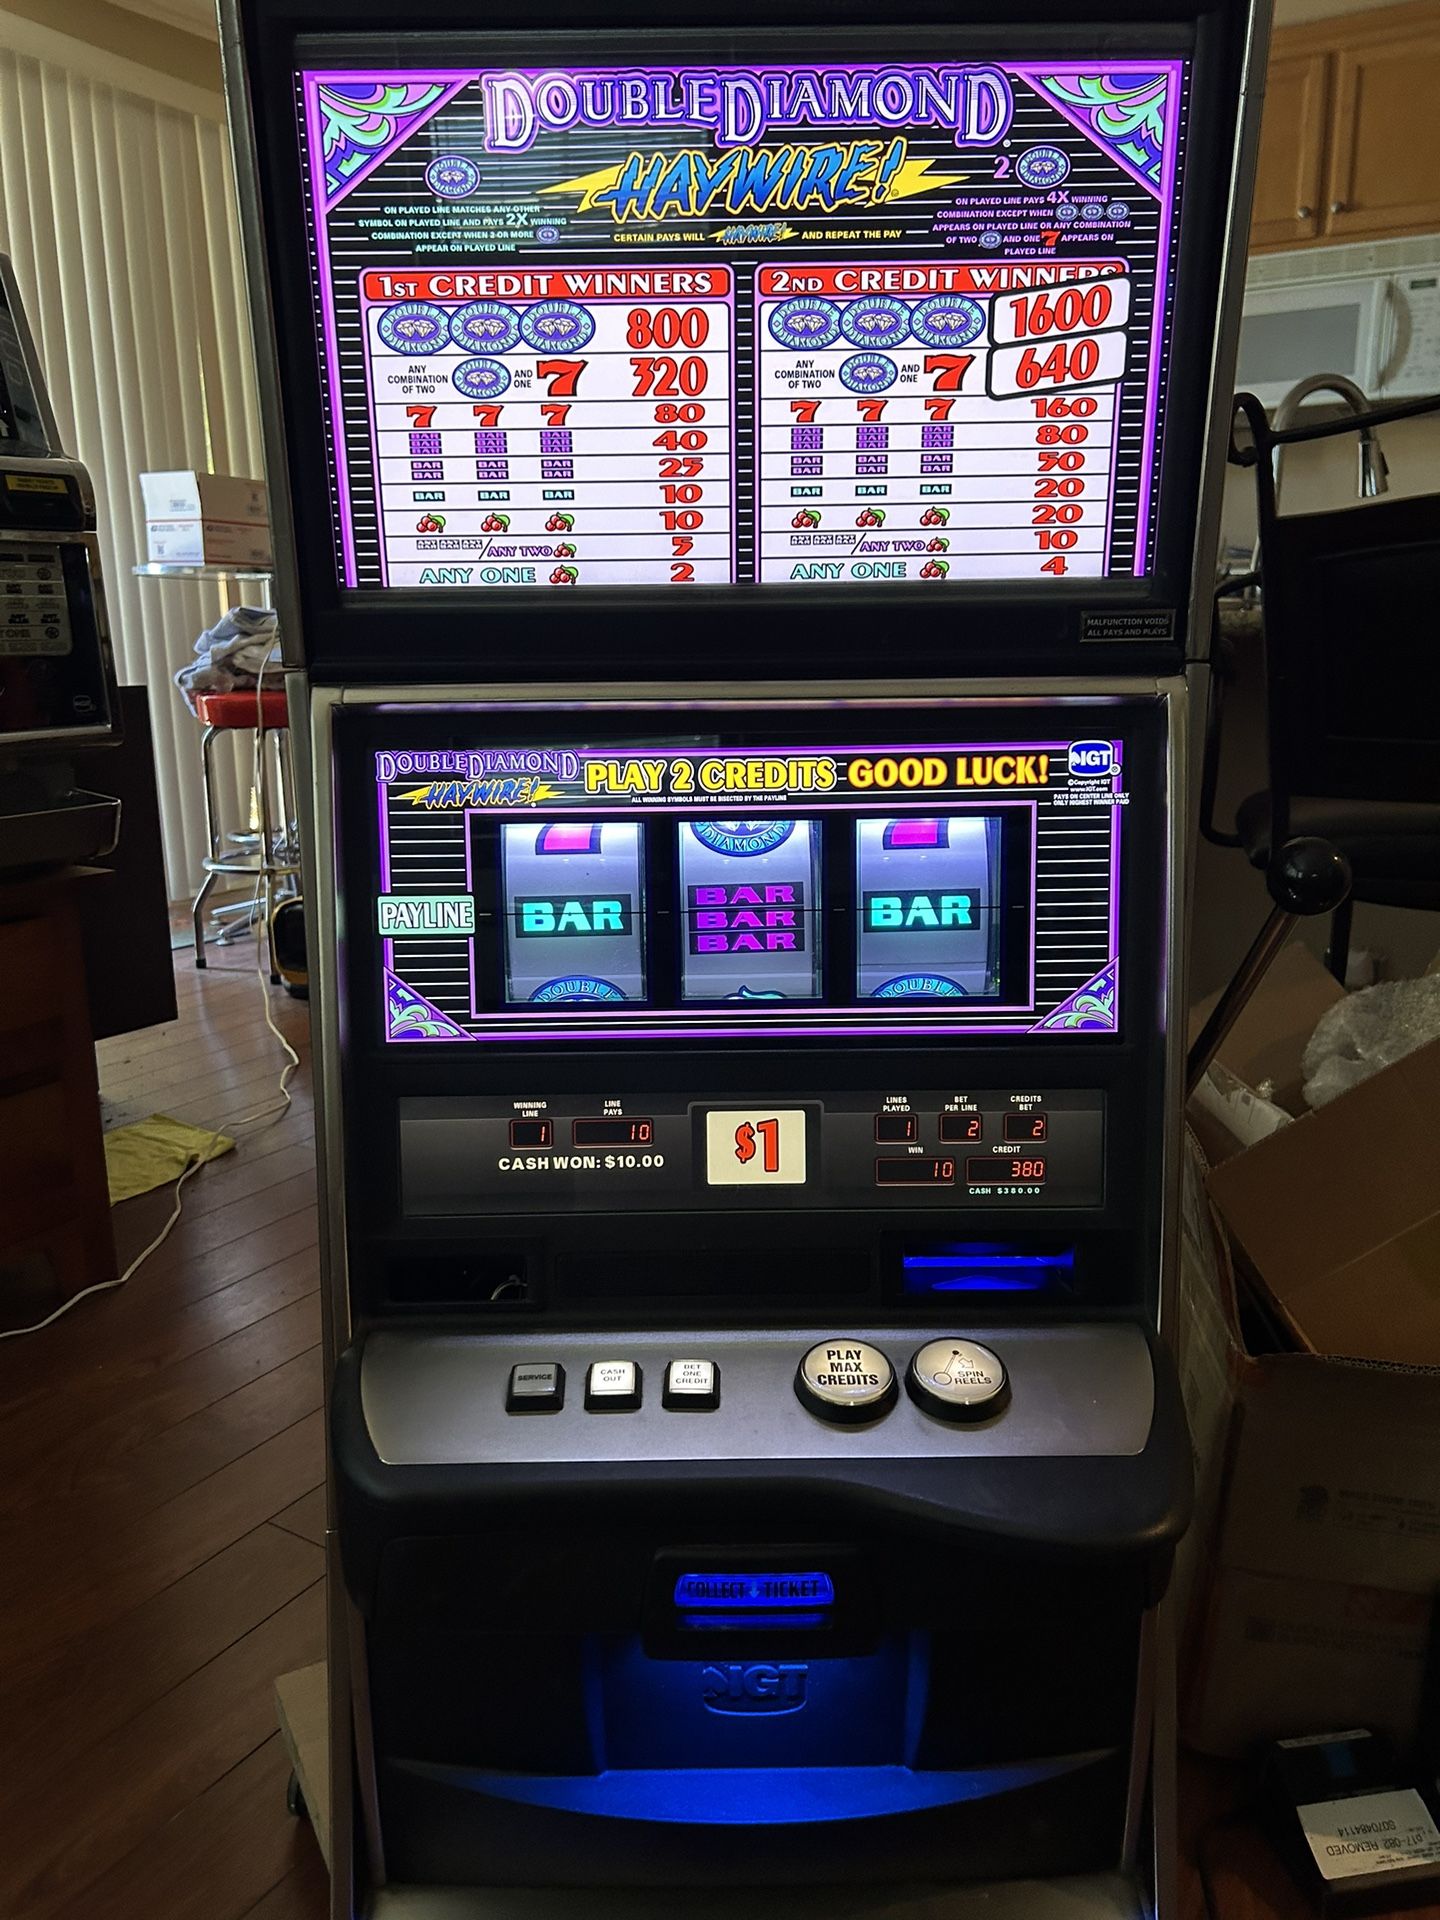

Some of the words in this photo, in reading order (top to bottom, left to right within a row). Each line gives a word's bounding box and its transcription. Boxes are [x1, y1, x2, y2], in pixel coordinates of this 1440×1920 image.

[591, 136, 907, 222] HAYWIRE!
[970, 197, 1001, 205] PLAYED
[1047, 191, 1069, 203] 4X
[506, 213, 528, 225] 2X
[937, 211, 994, 219] COMBINATION
[1054, 221, 1071, 229] ANY
[614, 233, 654, 242] CERTAIN
[657, 233, 680, 241] PAYS
[683, 232, 705, 240] WILL
[802, 231, 822, 239] AND
[826, 231, 861, 239] REPEAT
[864, 230, 881, 239] THE
[883, 230, 901, 238] PAY
[379, 276, 418, 297] 1ST
[428, 275, 552, 296] CREDIT
[564, 272, 712, 294] WINNERS
[771, 271, 823, 292] 2ND
[834, 269, 958, 291] CREDIT
[1010, 284, 1112, 338] 1600
[626, 308, 709, 349] 800
[408, 365, 426, 374] ANY
[796, 360, 814, 368] ANY
[901, 364, 920, 373] AND
[1016, 339, 1099, 389] 640
[388, 374, 448, 384] COMBINATION
[514, 370, 532, 379] AND
[514, 379, 531, 388] ONE
[630, 356, 708, 396] 320
[774, 370, 835, 379] COMBINATION
[900, 374, 918, 383] ONE
[402, 385, 413, 394] OF
[416, 385, 435, 394] TWO
[788, 381, 799, 389] OF
[802, 380, 821, 388] TWO
[654, 403, 705, 423] 80
[1031, 398, 1097, 418] 160
[653, 431, 708, 450] 40
[1035, 424, 1088, 445] 80
[658, 458, 704, 477] 25
[1038, 452, 1085, 472] 50
[659, 484, 703, 503] 10
[1034, 478, 1085, 498] 20
[659, 511, 703, 530] 10
[1032, 504, 1083, 524] 20
[672, 537, 694, 556] 5
[860, 540, 889, 552] ANY
[892, 540, 925, 551] TWO
[1034, 530, 1078, 550] 10
[488, 546, 516, 557] ANY
[520, 546, 552, 557] TWO
[670, 563, 694, 582] 2
[791, 563, 844, 579] ANY
[851, 562, 907, 578] ONE
[1040, 556, 1068, 575] 4
[419, 568, 473, 583] ANY
[481, 568, 536, 582] ONE
[1087, 618, 1142, 626] MALFUNCTION
[585, 759, 665, 792] PLAY
[672, 761, 693, 791] 2
[698, 757, 836, 792] CREDITS
[848, 757, 947, 788] GOOD
[956, 755, 1049, 785] LUCK!
[424, 777, 541, 809] HAYWIRE!
[702, 822, 787, 852] DIAMOND
[696, 886, 795, 905] BAR
[381, 902, 472, 929] PAYLINE
[522, 901, 623, 932] BAR
[697, 910, 795, 929] BAR
[871, 895, 972, 927] BAR
[698, 933, 796, 952] BAR
[537, 980, 622, 1001] DOUBLE
[877, 978, 962, 997] DOUBLE
[603, 1108, 622, 1116] PAYS
[541, 1126, 546, 1142] 1
[630, 1124, 650, 1140] 10
[906, 1121, 911, 1136] 1
[968, 1121, 978, 1136] 2
[1032, 1120, 1043, 1136] 2
[735, 1118, 779, 1172] $1
[498, 1157, 549, 1171] CASH
[553, 1157, 601, 1170] WON:
[605, 1155, 664, 1169] $10.00
[934, 1162, 953, 1177] 10
[1012, 1161, 1044, 1177] 380
[827, 1350, 862, 1360] PLAY
[830, 1362, 862, 1372] MAX
[818, 1374, 879, 1386] CREDITS
[954, 1377, 992, 1385] REELS
[687, 1582, 745, 1599] COLLECT
[763, 1580, 819, 1597] TICKET
[1326, 1841, 1379, 1856] REMOVED
